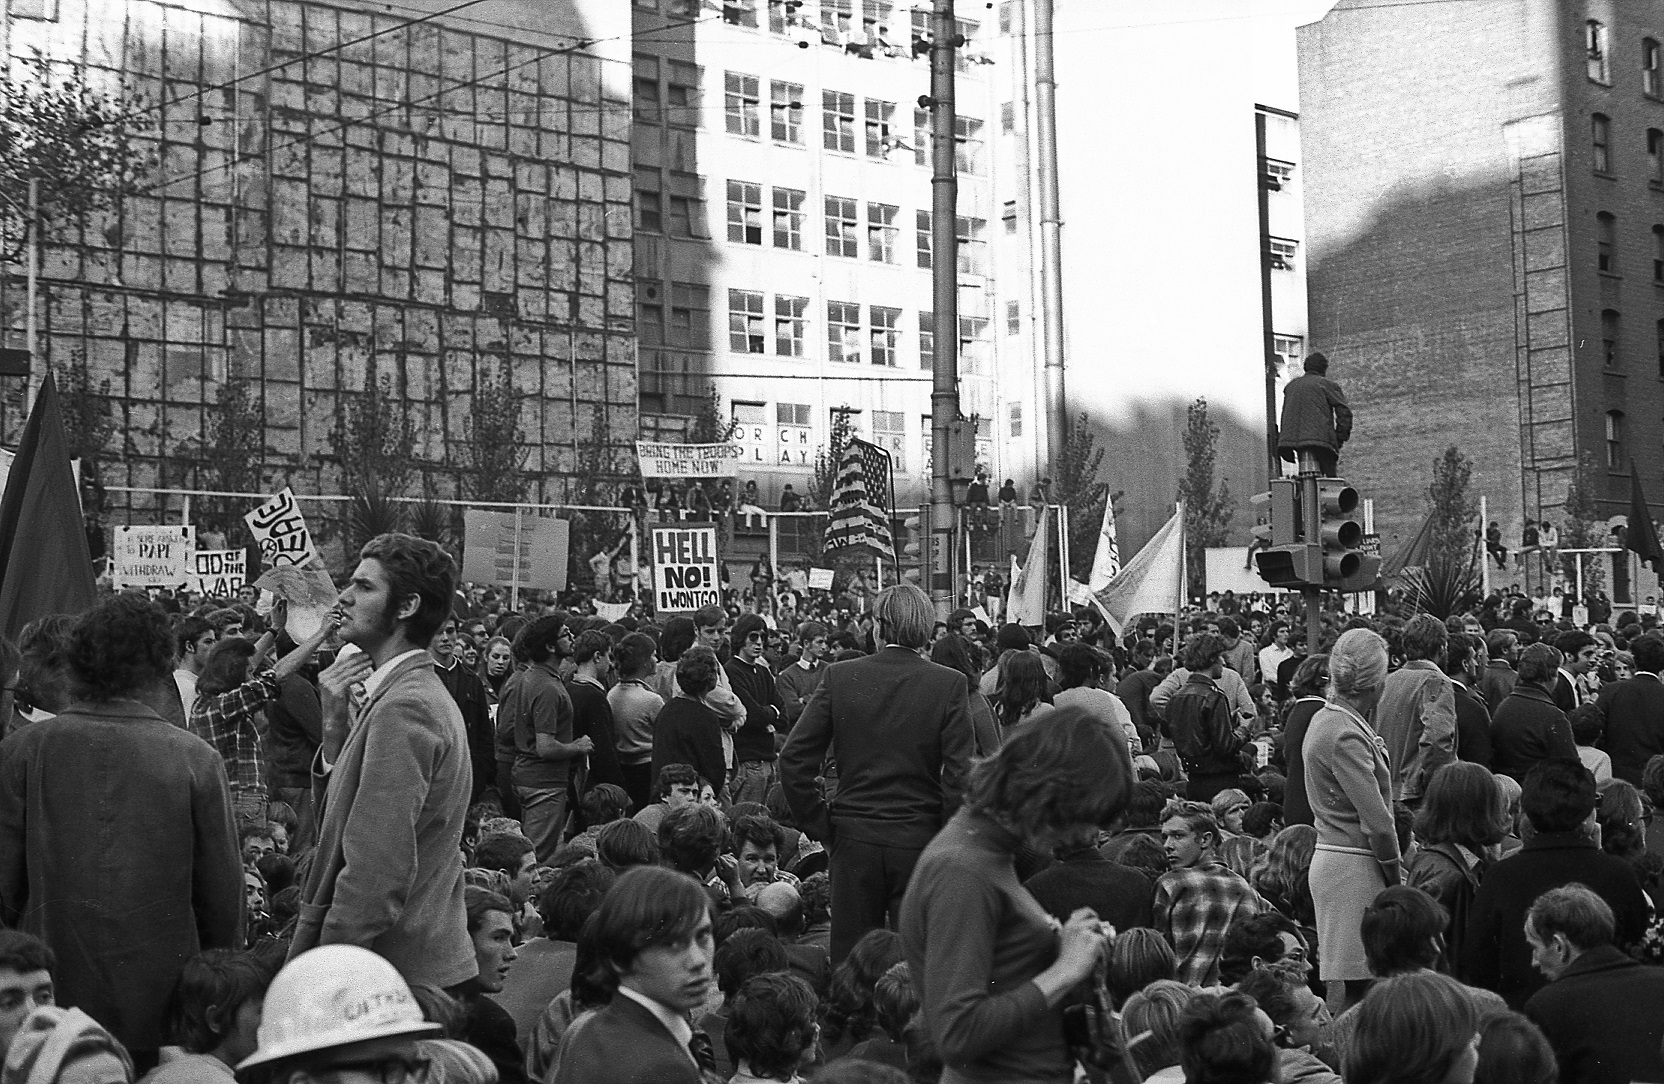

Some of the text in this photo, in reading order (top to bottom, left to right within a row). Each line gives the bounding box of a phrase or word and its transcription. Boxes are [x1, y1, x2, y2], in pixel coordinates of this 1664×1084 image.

[639, 445, 738, 459] BRING THE TROOPS
[656, 460, 688, 474] HOME
[656, 532, 714, 564] HELL
[224, 563, 244, 574] THE
[664, 566, 711, 589] NO!
[199, 577, 242, 598] WAR
[661, 591, 668, 609] I
[701, 590, 718, 606] GO
